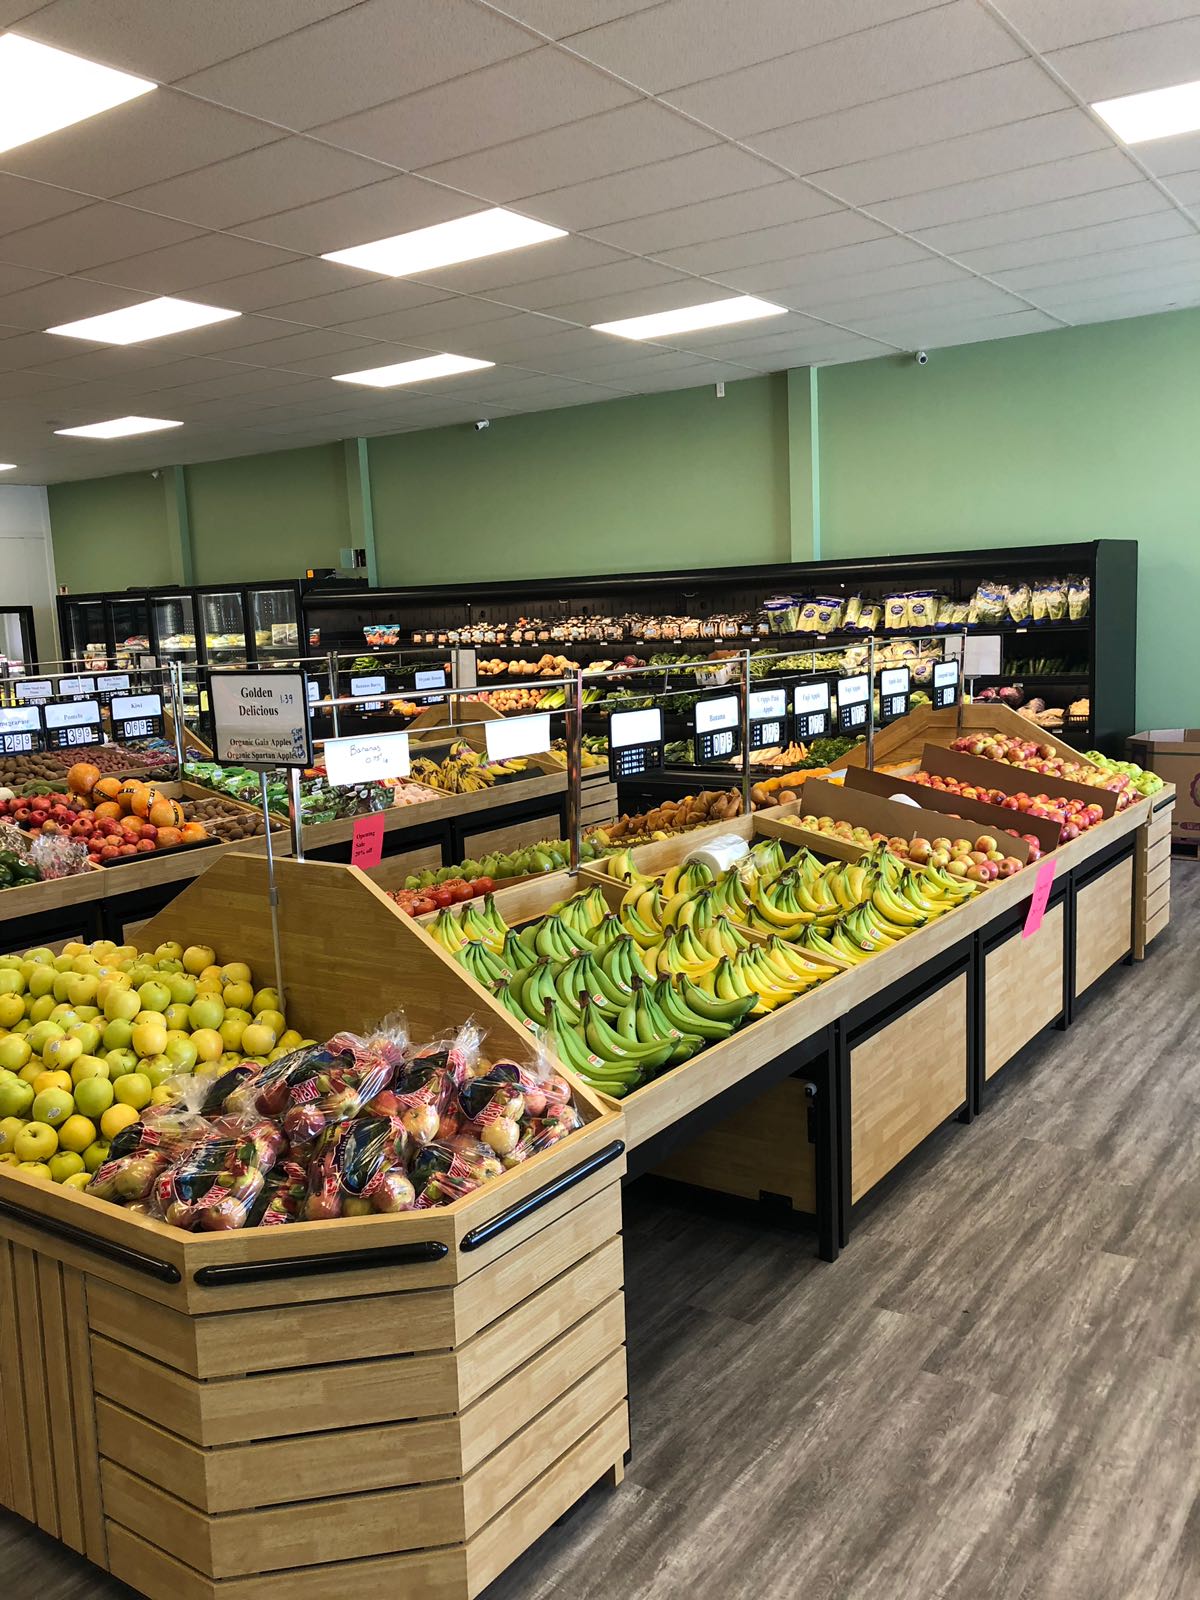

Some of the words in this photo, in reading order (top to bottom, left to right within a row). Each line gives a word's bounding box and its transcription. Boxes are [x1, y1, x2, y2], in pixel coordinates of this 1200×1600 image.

[240, 687, 273, 698] Golden
[239, 705, 279, 716] Delicious
[229, 738, 253, 747] Organic
[271, 738, 292, 748] Apples
[350, 744, 381, 756] Bananas
[227, 751, 251, 760] Organic
[251, 752, 275, 761] Spartan
